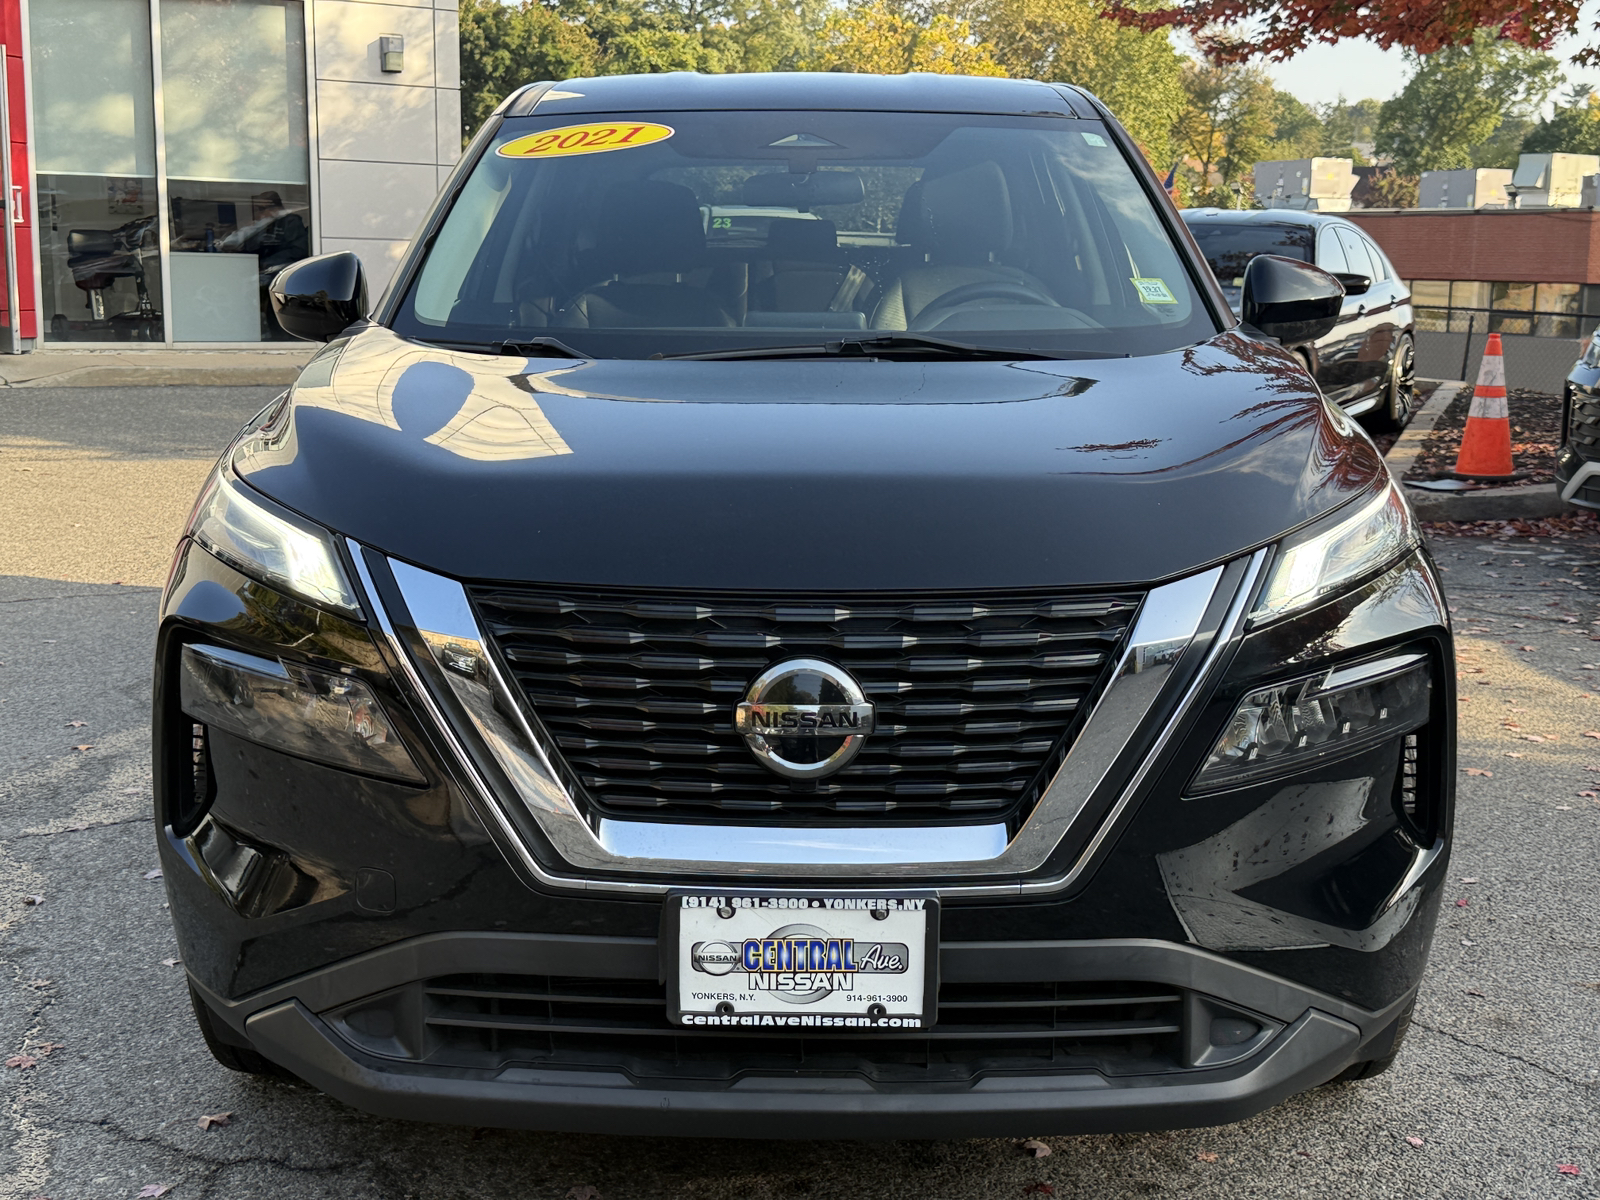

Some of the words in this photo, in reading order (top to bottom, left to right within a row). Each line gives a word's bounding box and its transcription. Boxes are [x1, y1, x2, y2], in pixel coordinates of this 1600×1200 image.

[524, 126, 646, 155] 2021
[712, 217, 732, 229] 23
[752, 711, 858, 728] NISSAN
[731, 897, 809, 910] 961-3900
[742, 938, 859, 973] CENTRAL
[860, 944, 904, 970] Ave.
[748, 972, 853, 991] NISSAN
[691, 992, 738, 1002] YONKERS,
[739, 993, 756, 1002] N.Y.
[846, 994, 908, 1003] 914-961-3900
[681, 1014, 922, 1028] CentralAveNissan.com
